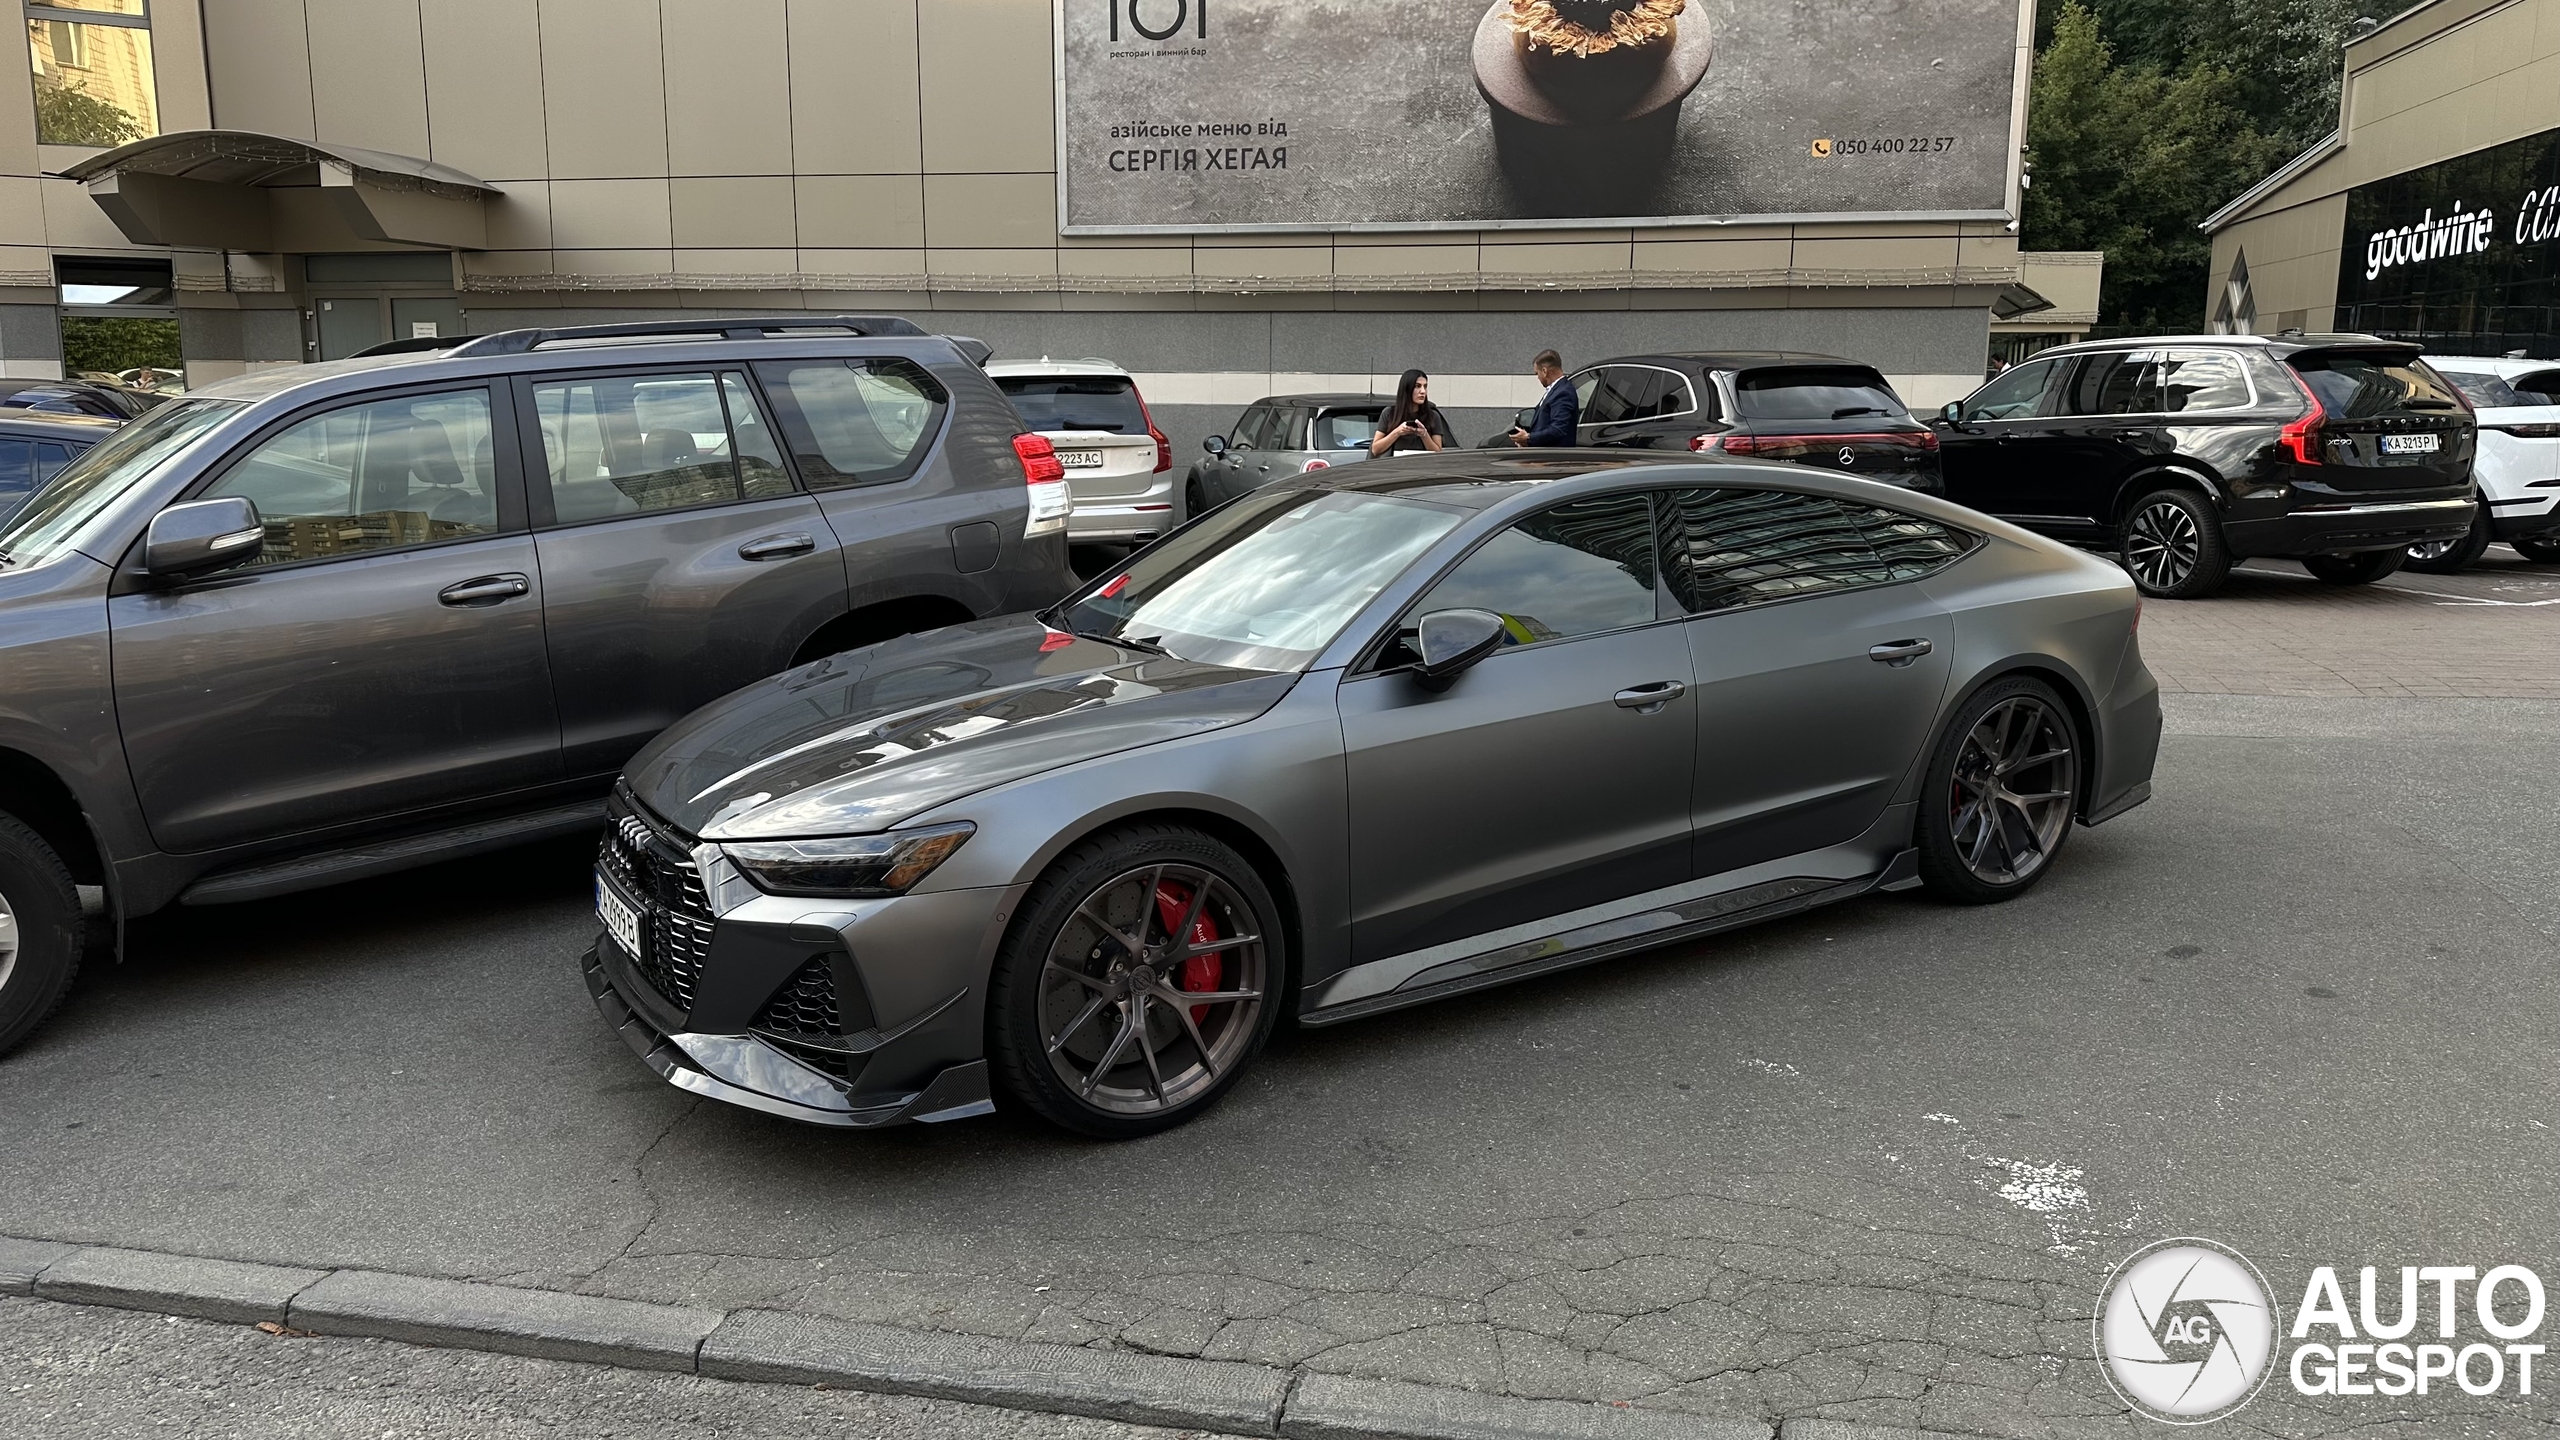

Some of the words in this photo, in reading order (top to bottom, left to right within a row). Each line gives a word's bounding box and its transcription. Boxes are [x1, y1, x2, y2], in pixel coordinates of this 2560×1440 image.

[1109, 50, 1150, 60] ресторан
[1156, 47, 1189, 57] винний
[1190, 46, 1207, 57] бар
[1110, 120, 1192, 138] азійське
[1198, 122, 1252, 137] меню
[1257, 117, 1288, 137] від
[1836, 139, 1867, 154] 050
[1871, 138, 1904, 153] 400
[1908, 137, 1929, 153] 22
[1933, 137, 1954, 152] 57
[1108, 148, 1197, 172] СЕРГІЯ
[1204, 146, 1287, 171] ХЕГАЯ
[2365, 200, 2493, 281] goodwine
[2327, 438, 2353, 446] XC90
[2387, 437, 2401, 450] KA
[2402, 436, 2423, 449] 3213
[1084, 453, 1099, 464] AC
